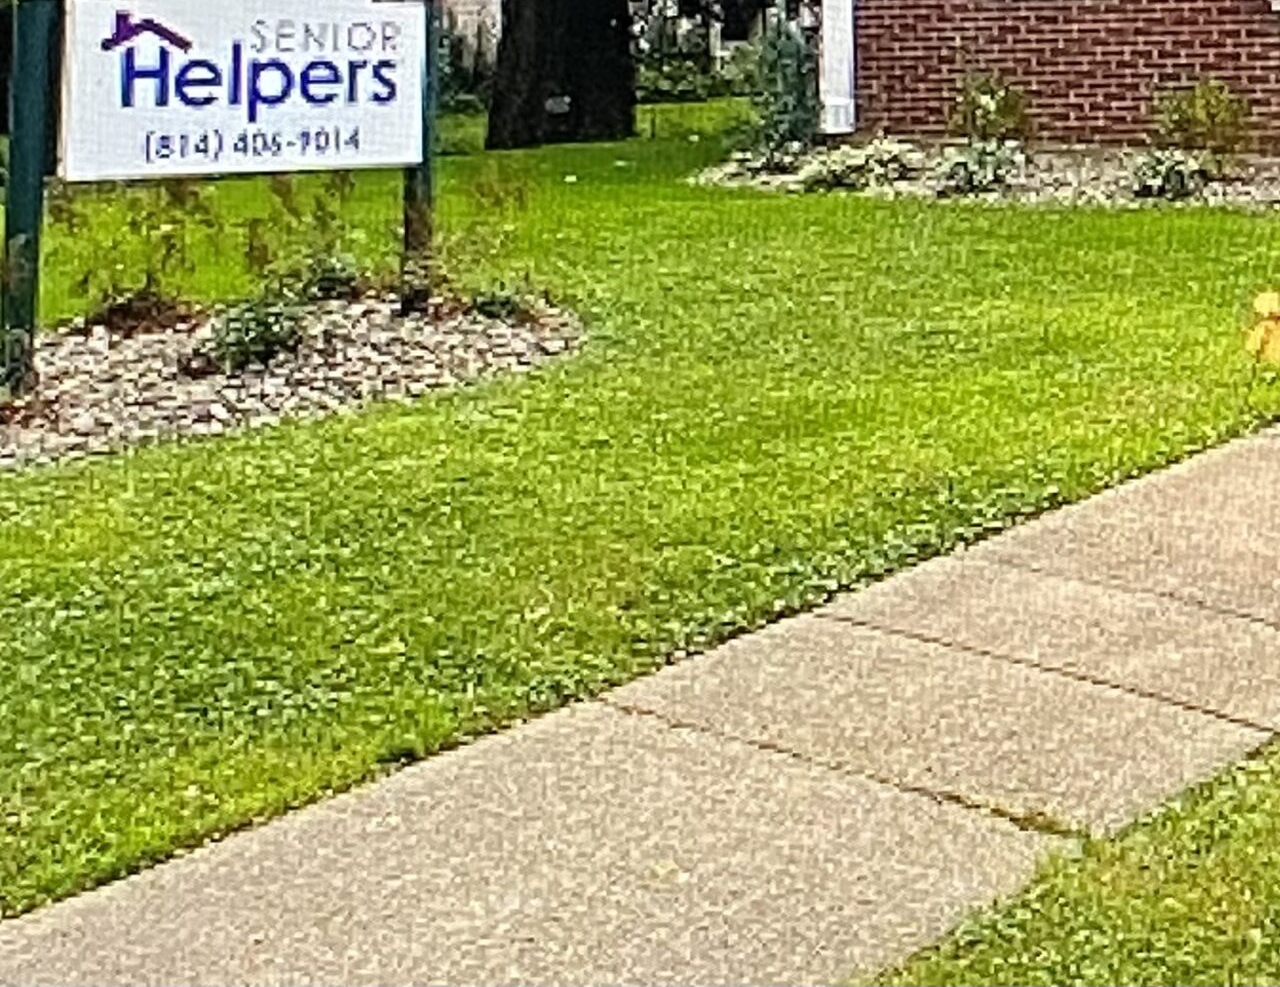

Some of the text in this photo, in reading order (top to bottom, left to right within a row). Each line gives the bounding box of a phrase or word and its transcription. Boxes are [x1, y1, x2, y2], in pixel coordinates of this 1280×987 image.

[249, 19, 400, 53] SENIOR
[121, 40, 397, 123] Helpers
[145, 129, 223, 164] (814)
